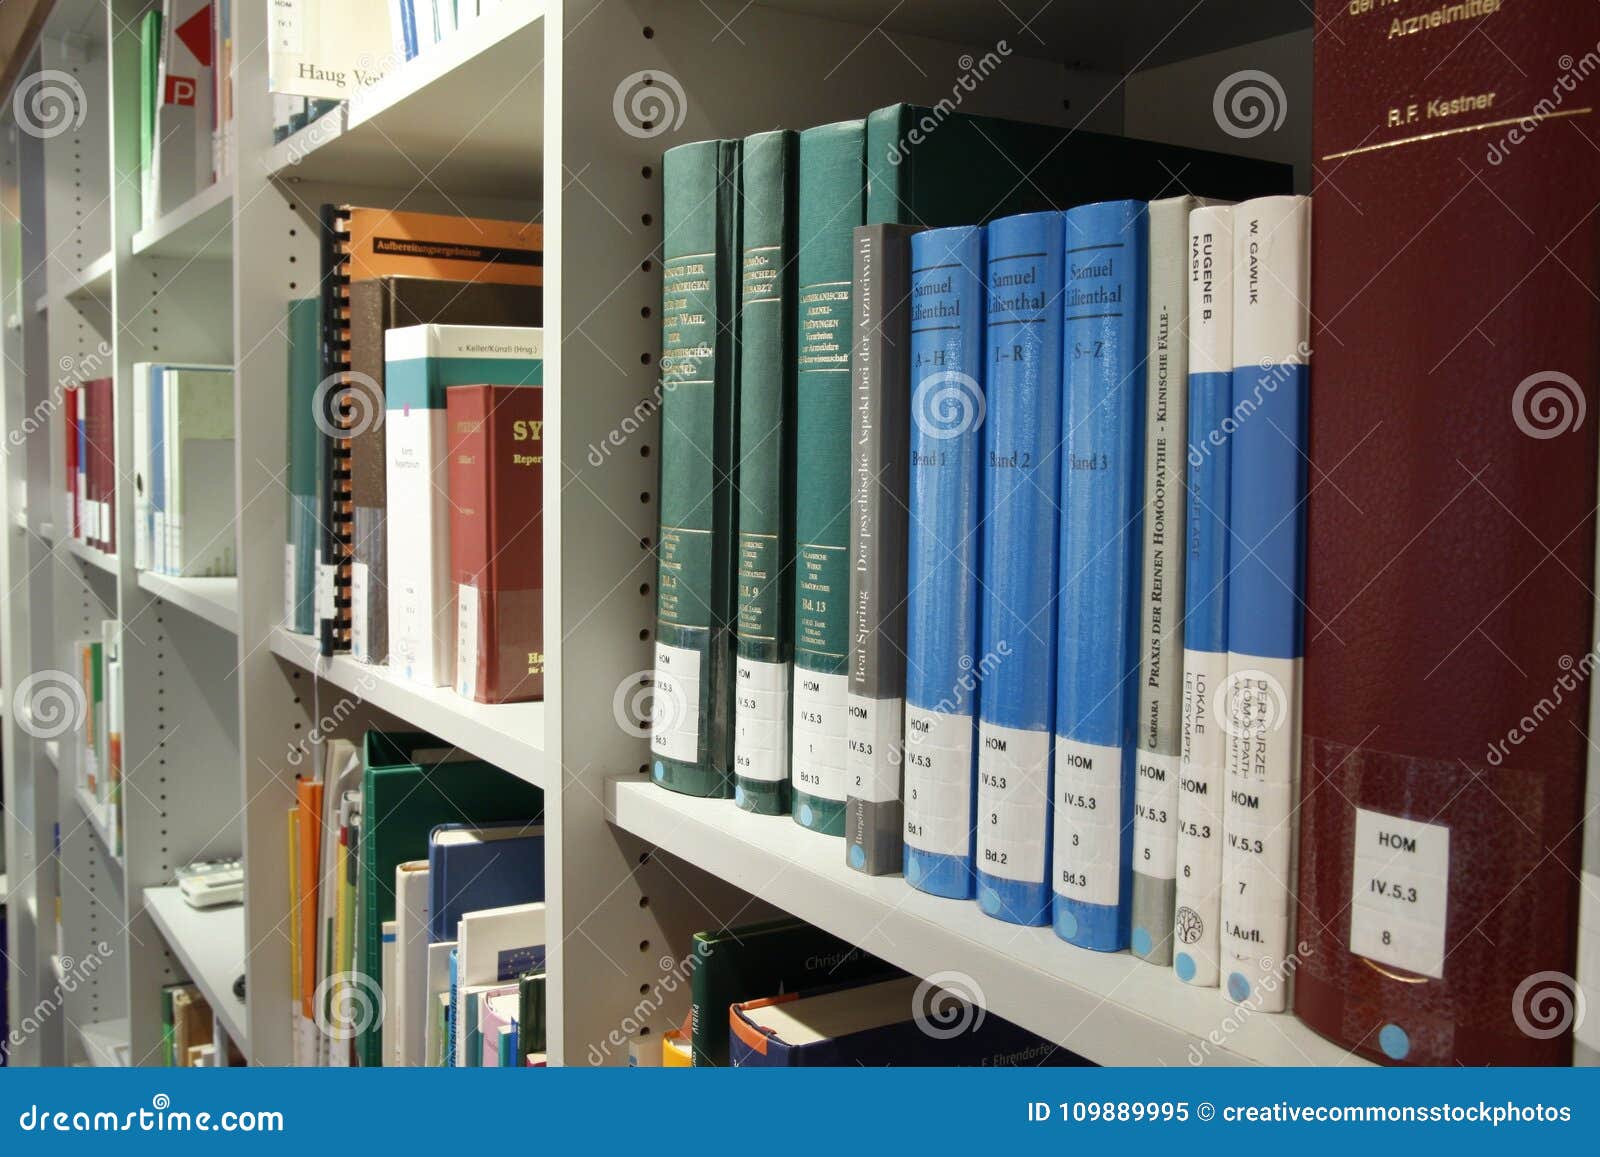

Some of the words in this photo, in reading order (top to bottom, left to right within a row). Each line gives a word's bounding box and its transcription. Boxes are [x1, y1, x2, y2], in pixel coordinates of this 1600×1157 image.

[298, 63, 346, 87] Haug
[1427, 92, 1496, 119] Kastner
[992, 267, 1036, 287] Samuel
[1071, 259, 1113, 280] Samuel
[1203, 233, 1213, 304] EUGENE
[1249, 242, 1259, 304] GAWLIK
[860, 238, 871, 327] Arzneiwahl
[914, 277, 951, 297] Samuel
[912, 300, 960, 321] Lilienthal
[988, 291, 1045, 314] Lilienthal
[1203, 309, 1212, 324] B.
[1157, 313, 1169, 350] FÄLLE
[859, 336, 870, 362] der
[858, 367, 870, 391] bei
[1157, 354, 1168, 422] KLINISCHE
[858, 393, 872, 446] Aspekt
[513, 454, 543, 466] Reper
[990, 451, 1017, 468] Band
[1021, 453, 1030, 468] 2
[1101, 455, 1108, 469] 3
[1153, 438, 1167, 545] HOMÖOPATHIE
[1151, 550, 1163, 603] REINEN
[816, 601, 826, 613] 13
[855, 591, 870, 645] Spring
[1148, 639, 1160, 688] PRAXIS
[803, 680, 819, 692] HOM
[849, 706, 867, 719] HOM
[1195, 673, 1205, 734] LOKALE
[801, 712, 822, 724] IV.5.3
[910, 719, 929, 733] HOM
[1149, 700, 1159, 749] CARRARA
[849, 740, 873, 755] IV.5.3
[985, 738, 1007, 752] HOM
[1254, 718, 1266, 774] KURZE
[908, 753, 931, 768] IV.5.3
[1067, 754, 1093, 770] HOM
[800, 771, 820, 785] Bd.13
[855, 776, 861, 786] 2
[982, 773, 1007, 789] IV.5.3
[1140, 765, 1165, 781] HOM
[912, 789, 918, 800] 3
[1181, 778, 1207, 795] HOM
[1064, 792, 1096, 810] IV.5.3
[1231, 791, 1259, 809] HOM
[991, 813, 998, 825] 3
[1135, 804, 1167, 823] IV.5.3
[908, 822, 922, 837] Bd.1
[1072, 834, 1079, 846] 3
[1229, 832, 1263, 853] IV.5.3
[1378, 831, 1416, 853] HOM
[985, 849, 1007, 864] Bd.2
[1144, 848, 1151, 860] 5
[1063, 870, 1086, 887] Bd.3
[1183, 865, 1191, 877] 6
[1239, 881, 1247, 895] 7
[1371, 879, 1417, 903] IV.5.3
[1226, 921, 1264, 944] 1.Aufl.
[1381, 930, 1391, 945] 8
[806, 951, 853, 970] Christina
